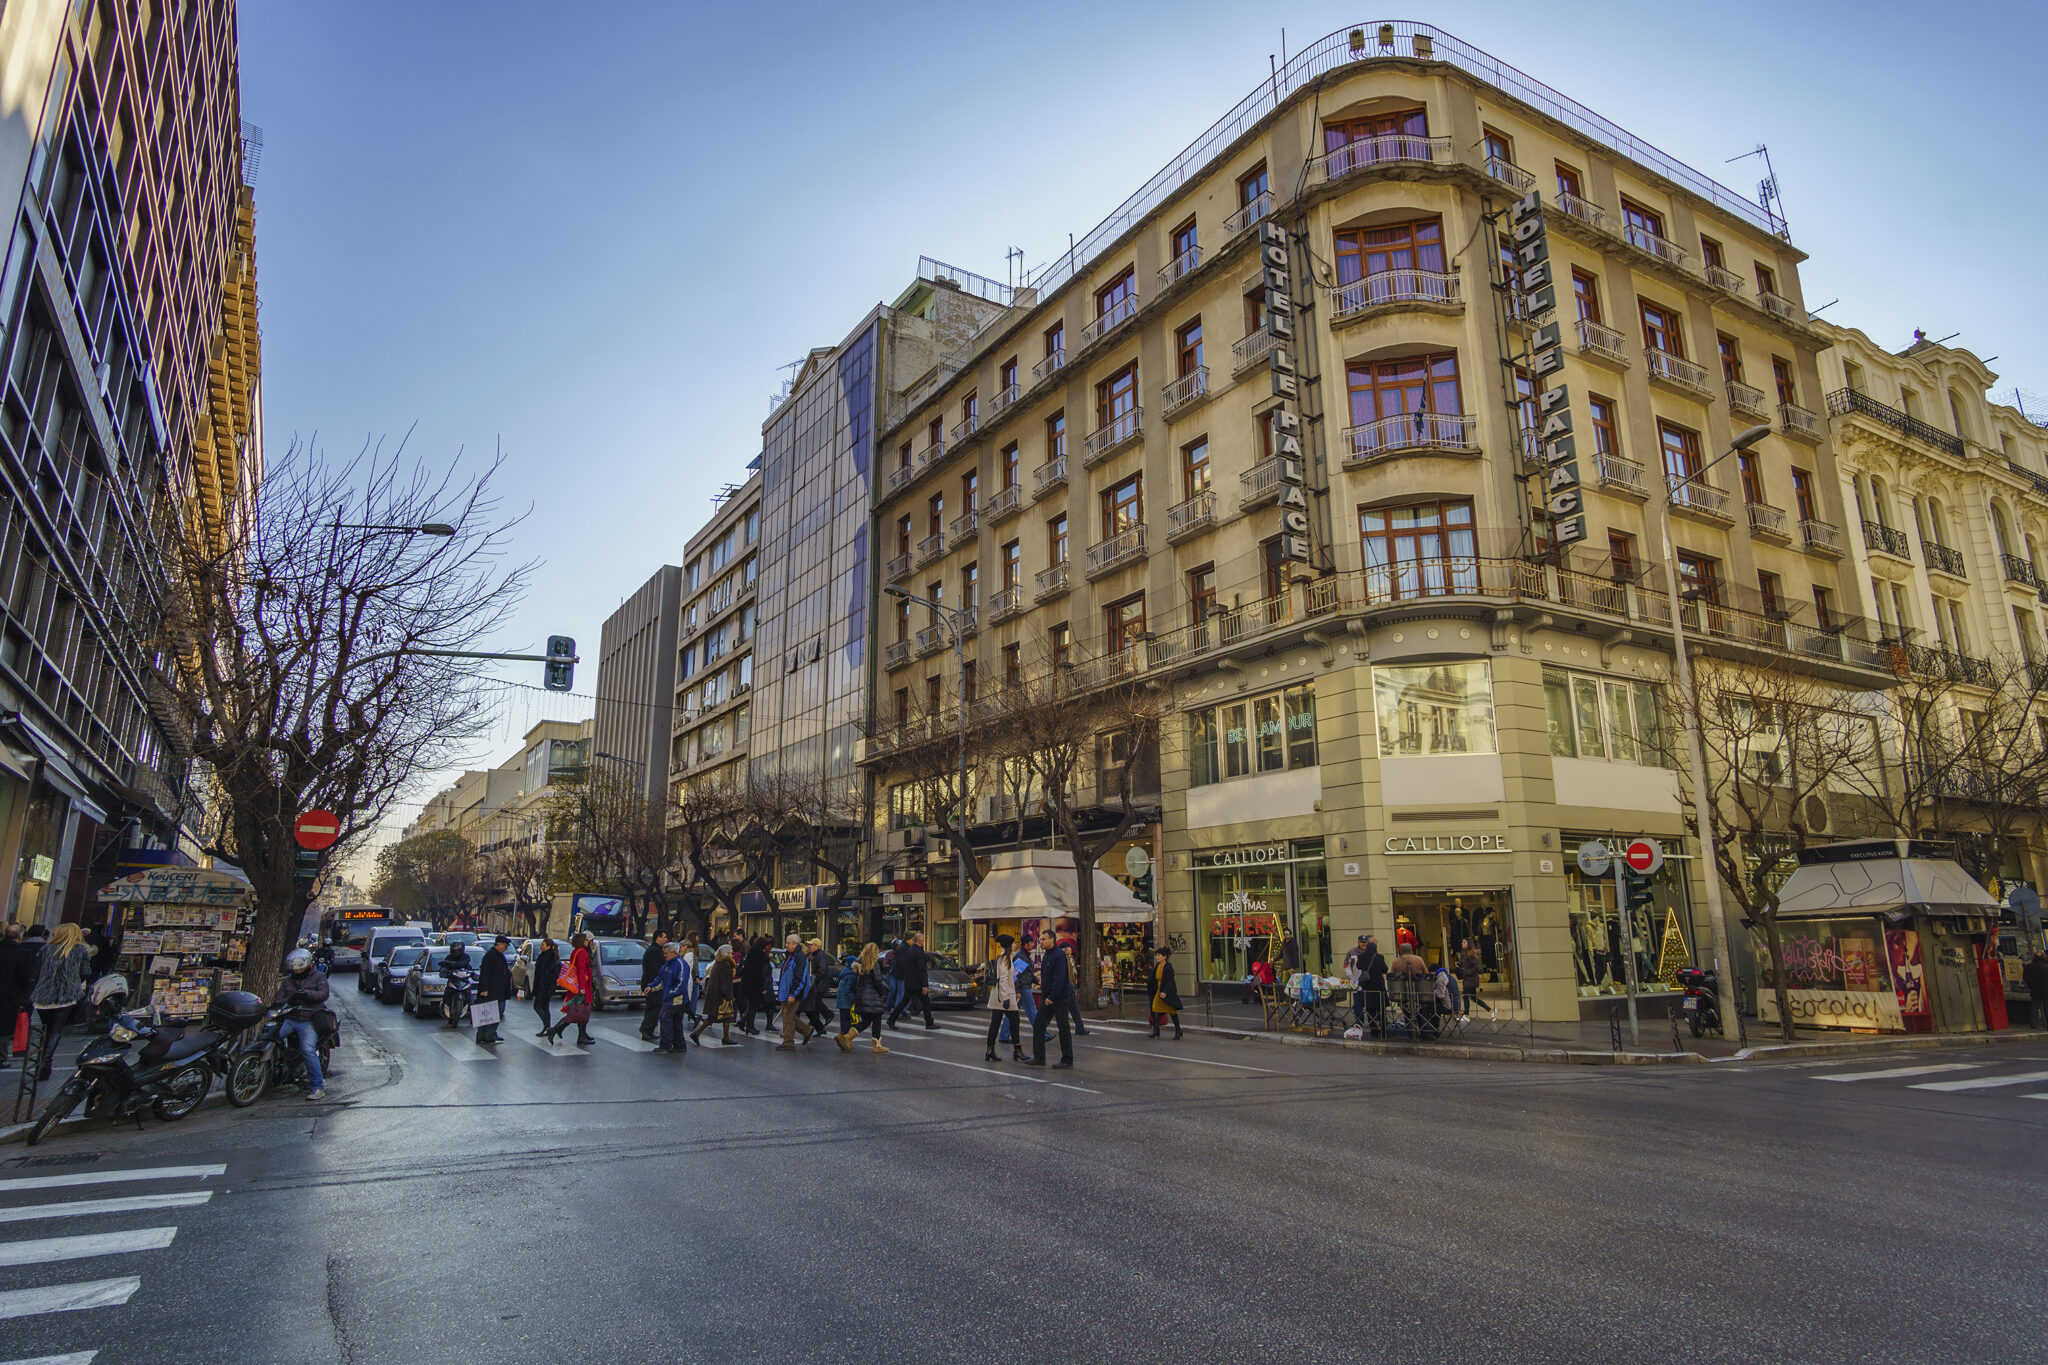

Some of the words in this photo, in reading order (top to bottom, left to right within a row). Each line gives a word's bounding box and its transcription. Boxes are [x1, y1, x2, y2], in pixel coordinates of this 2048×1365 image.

[1512, 192, 1549, 314] HOTEL
[1267, 222, 1291, 335] HOTEL
[1531, 329, 1557, 375] LE
[1278, 350, 1296, 395] LE
[1540, 388, 1579, 542] PALACE
[1281, 410, 1307, 557] PALACE
[1227, 727, 1244, 743] BE
[1213, 846, 1285, 866] CALLIOPE
[1385, 835, 1507, 851] CALLIOPE
[148, 871, 200, 883] KeyCERT
[1217, 901, 1267, 912] CHRISTMAS
[1211, 916, 1275, 935] OFFERS
